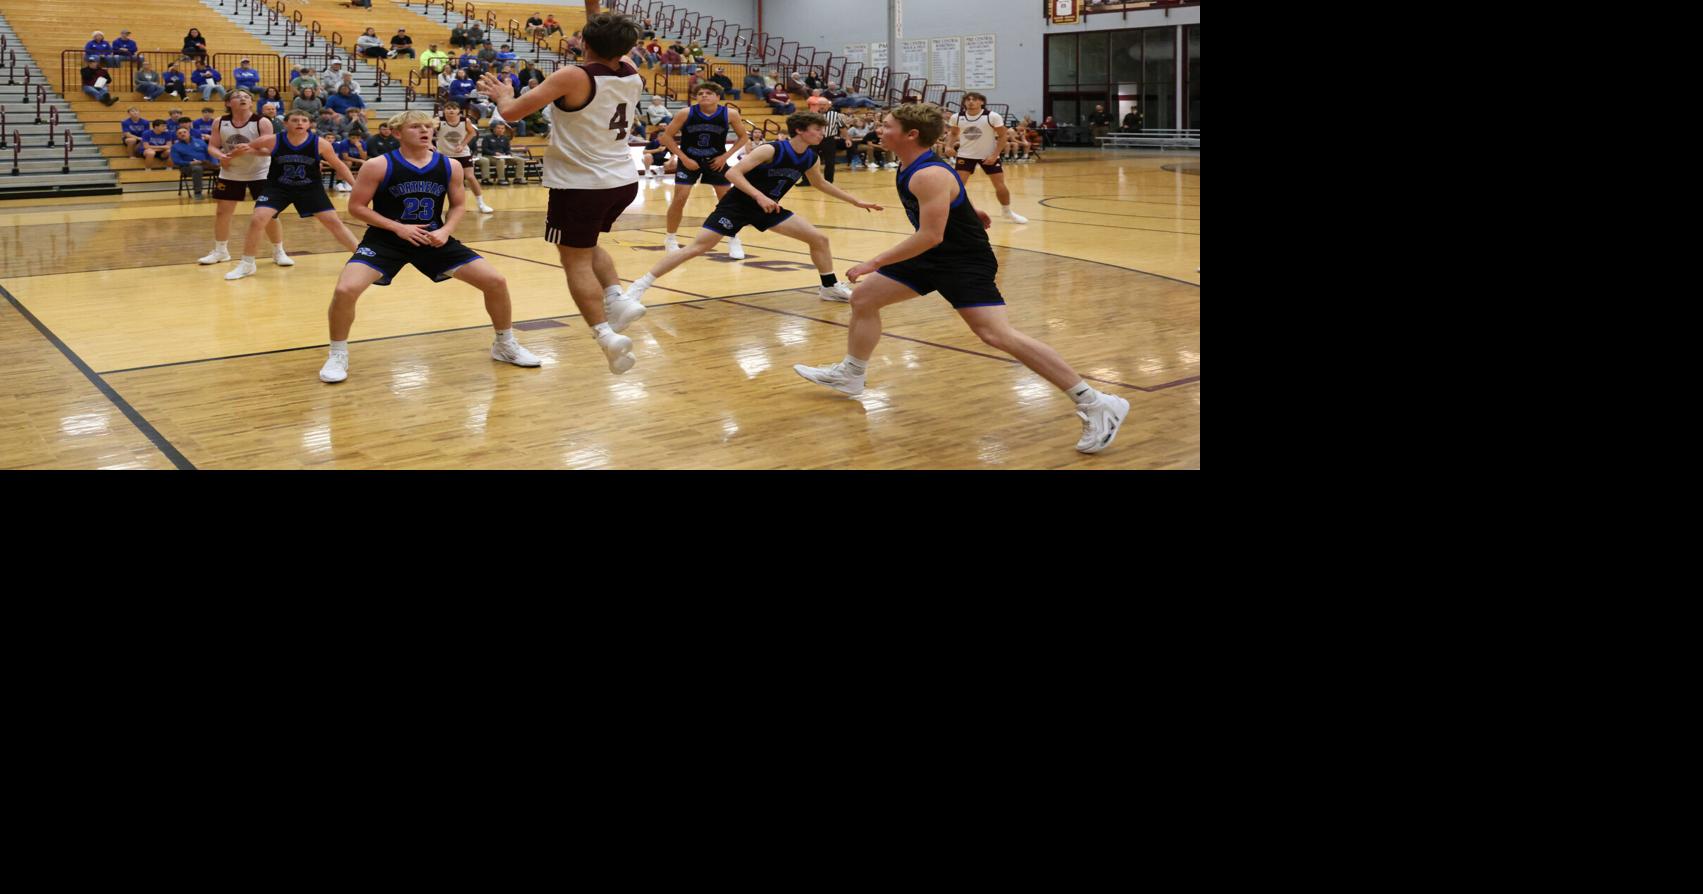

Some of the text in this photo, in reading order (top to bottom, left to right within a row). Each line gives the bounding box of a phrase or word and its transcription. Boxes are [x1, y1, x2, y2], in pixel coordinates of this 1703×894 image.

[609, 102, 628, 141] 4
[697, 133, 710, 147] 3
[283, 164, 306, 179] 24
[401, 197, 435, 220] 23
